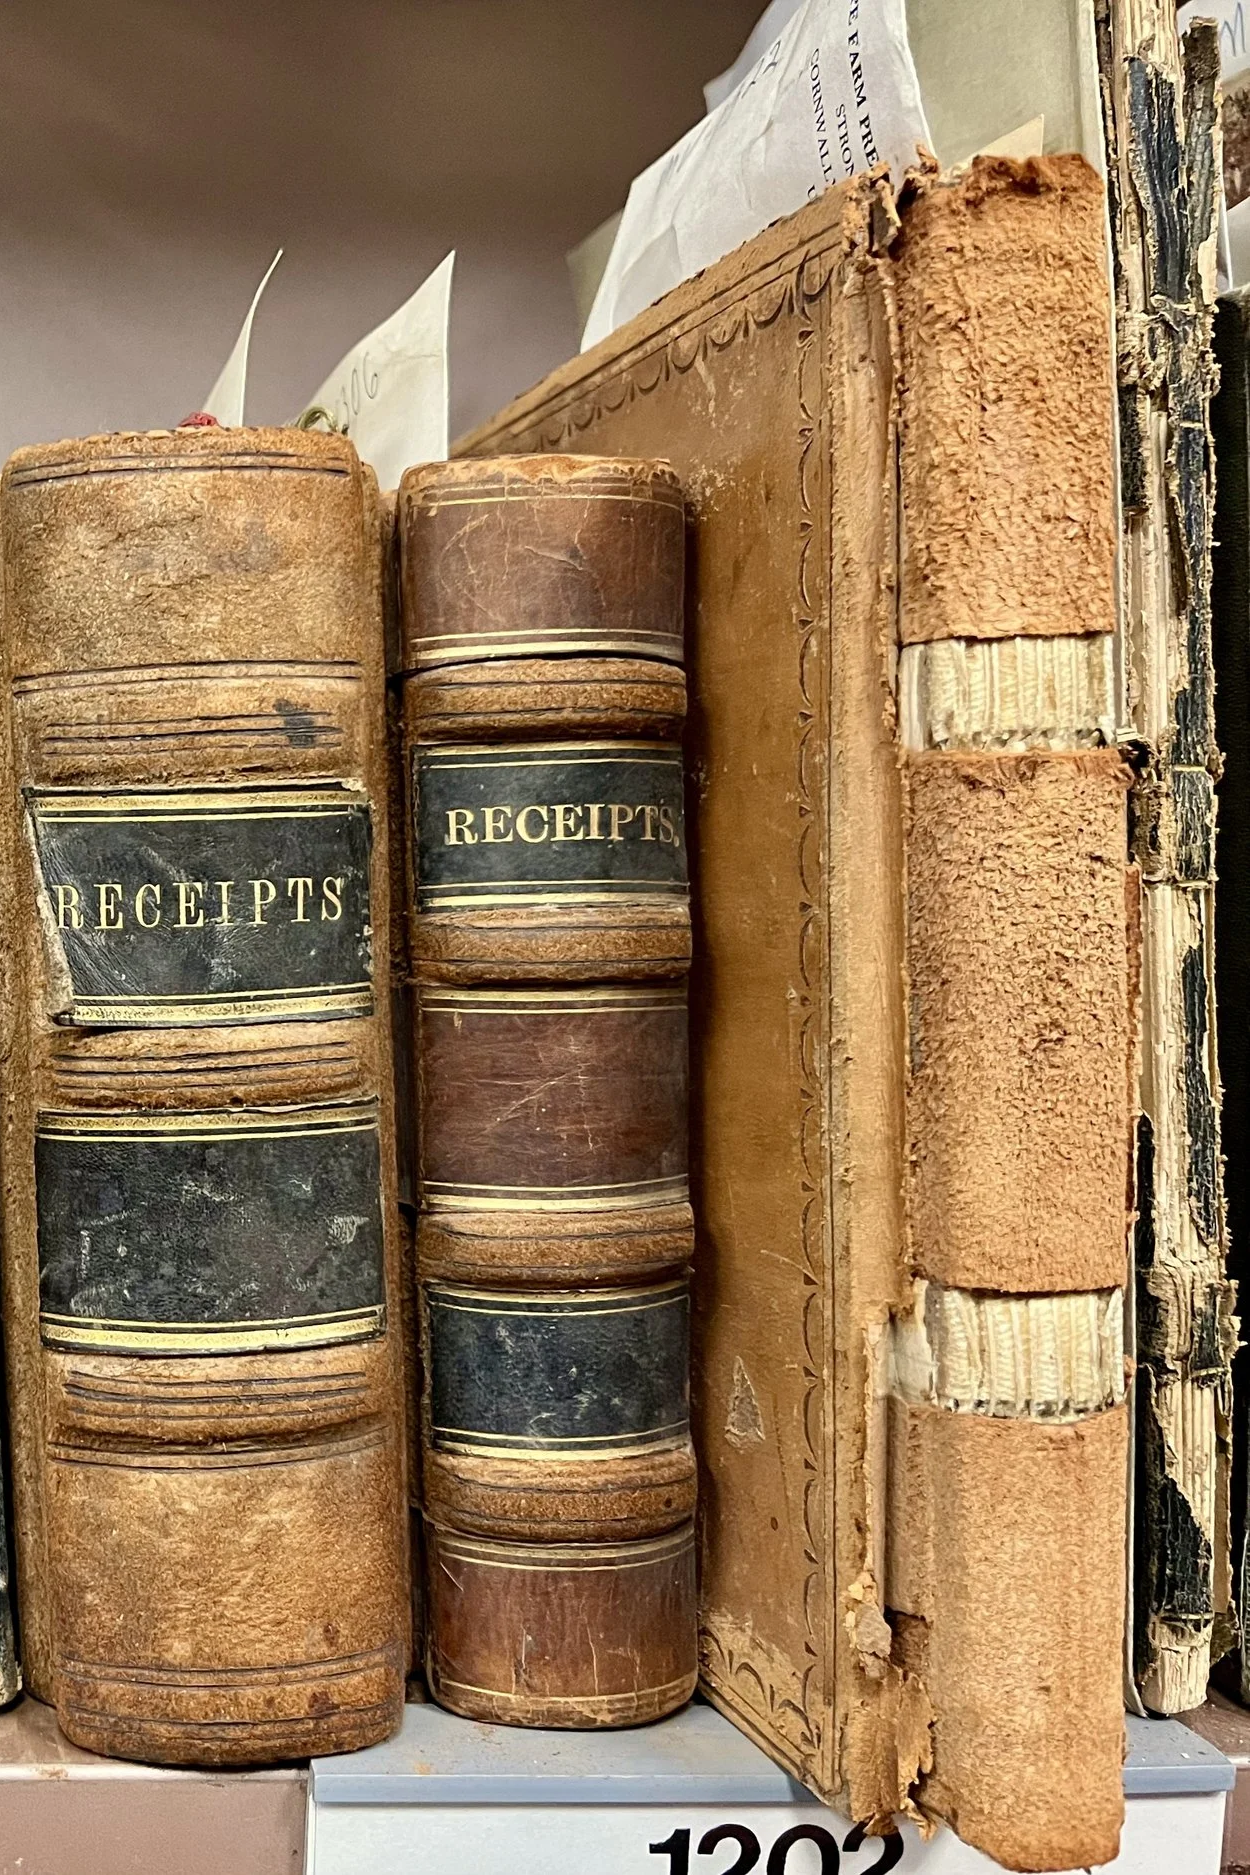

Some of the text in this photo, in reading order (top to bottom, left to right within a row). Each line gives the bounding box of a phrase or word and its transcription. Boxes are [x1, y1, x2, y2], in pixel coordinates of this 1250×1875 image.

[848, 30, 867, 109] FARM
[810, 48, 836, 185] CORNWALL
[52, 876, 346, 930] RECEIPTS
